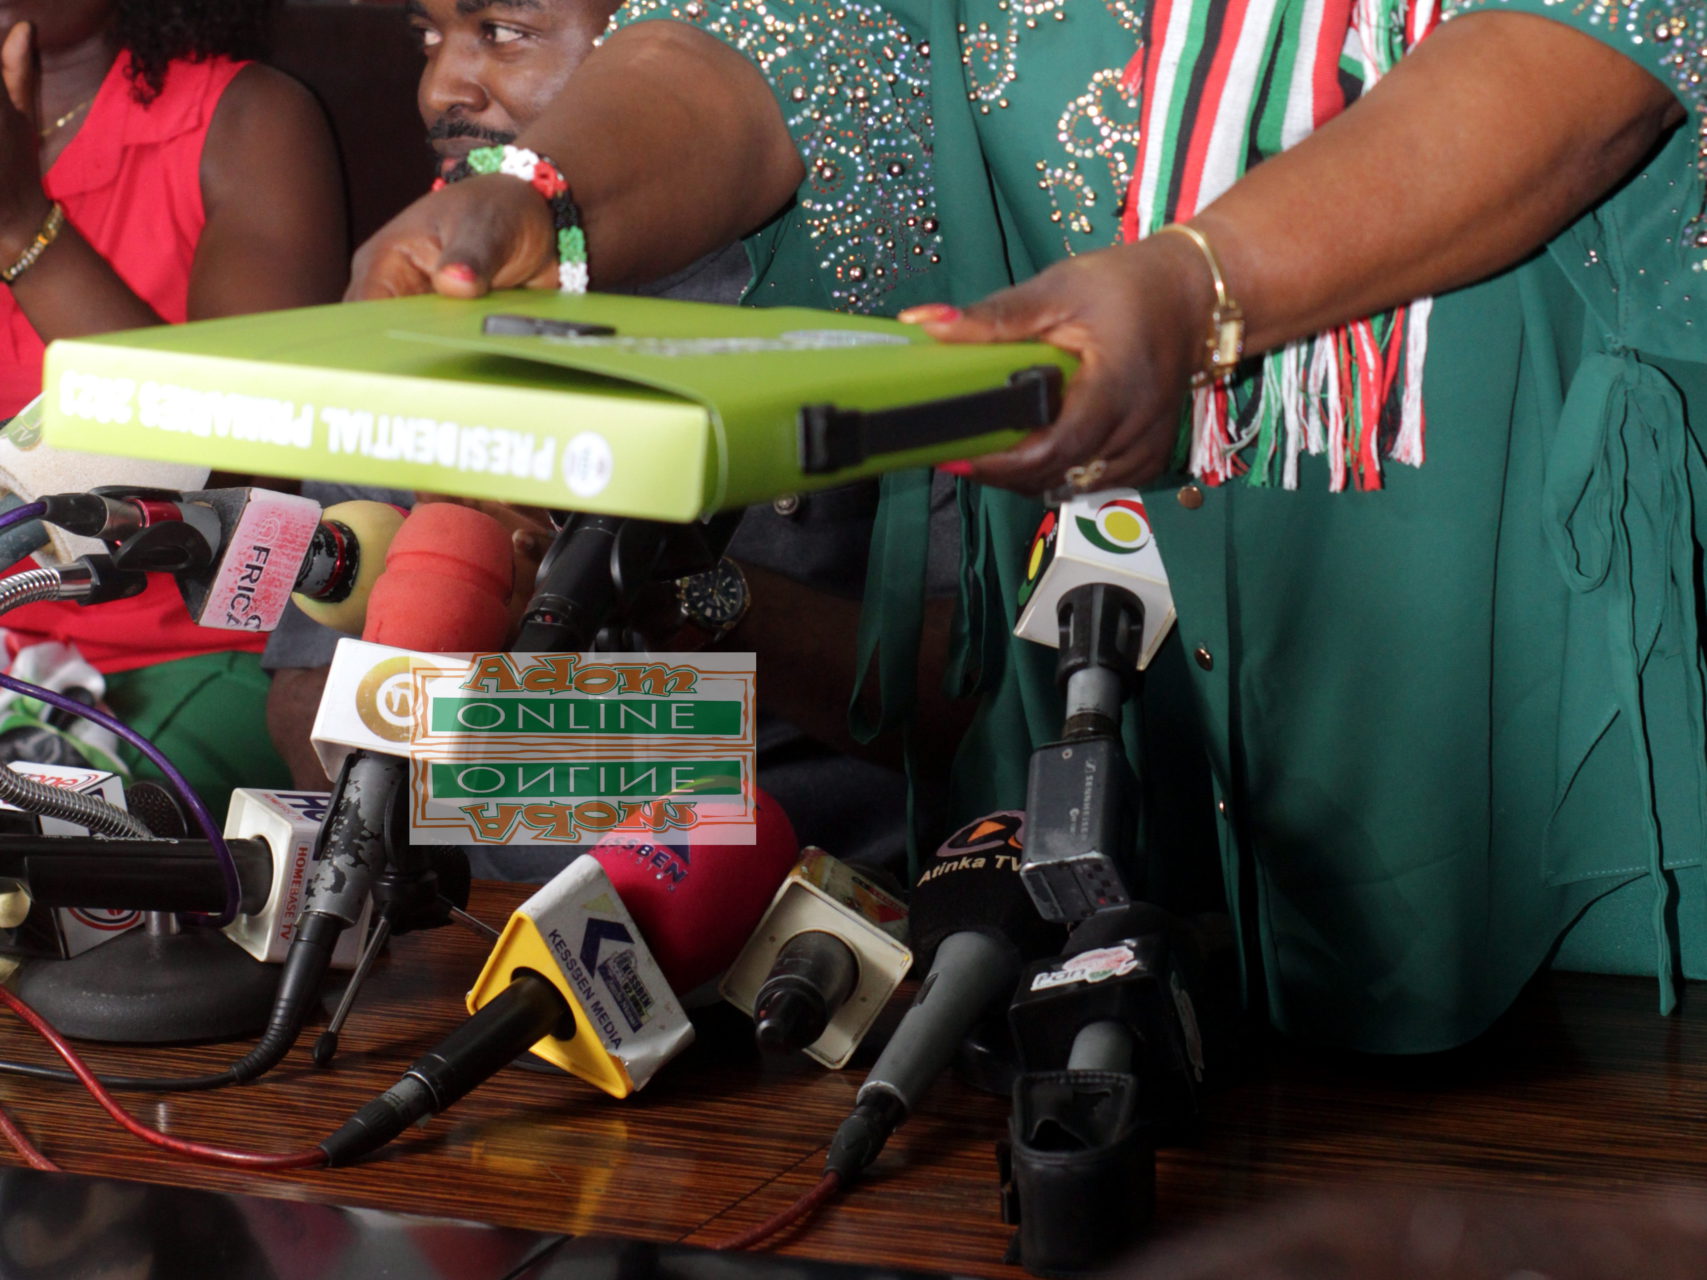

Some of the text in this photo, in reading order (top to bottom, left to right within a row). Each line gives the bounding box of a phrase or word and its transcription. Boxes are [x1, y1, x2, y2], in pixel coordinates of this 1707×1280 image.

[320, 406, 557, 481] PRESIDENTIAL
[279, 846, 309, 941] HOMEBASE TV
[916, 856, 986, 888] Atinka
[547, 927, 596, 1006] KESSBEN
[589, 1000, 624, 1051] MEDIA
